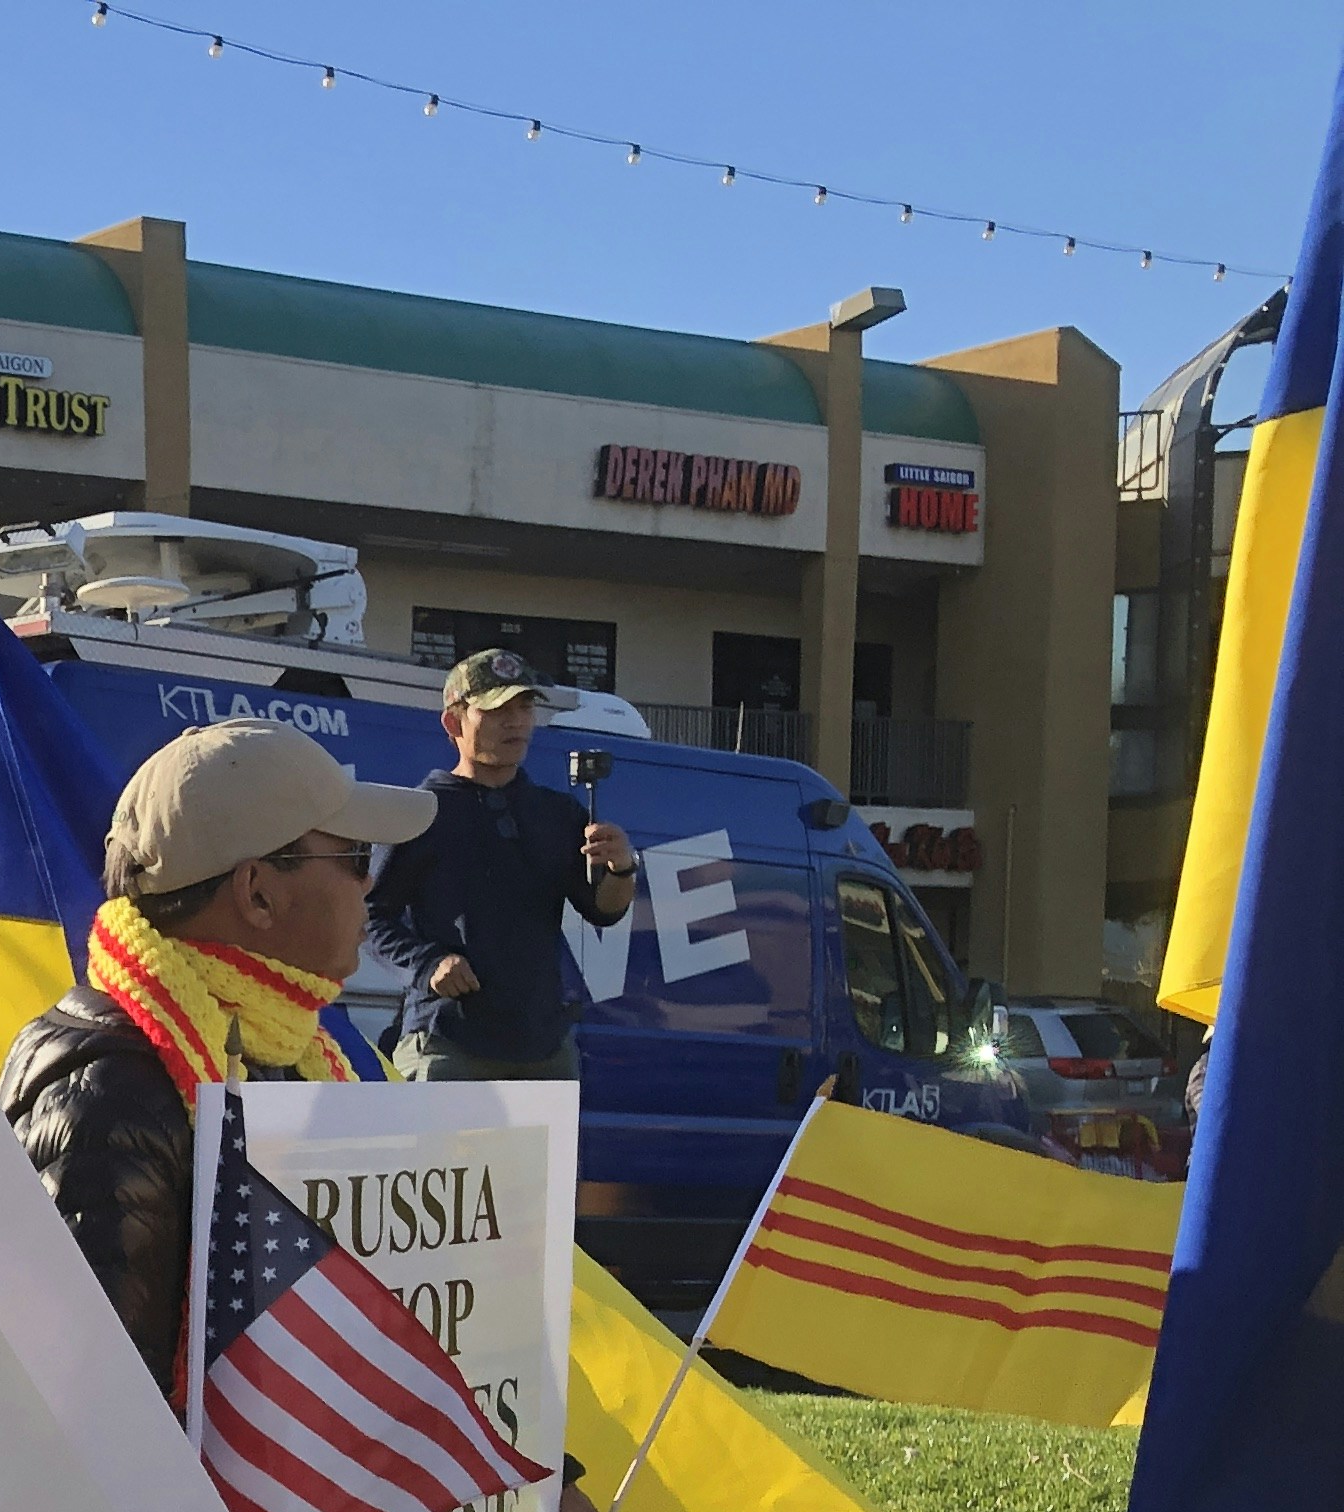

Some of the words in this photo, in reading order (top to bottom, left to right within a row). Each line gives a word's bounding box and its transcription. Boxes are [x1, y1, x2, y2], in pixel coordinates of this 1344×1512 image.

[0, 376, 109, 435] TRUST
[605, 445, 686, 503] DEREK
[689, 454, 759, 512] PHAN
[762, 463, 802, 515] MD
[899, 466, 930, 482] LITTLE
[899, 486, 980, 532] HOME
[302, 1164, 502, 1257] RUSSIA
